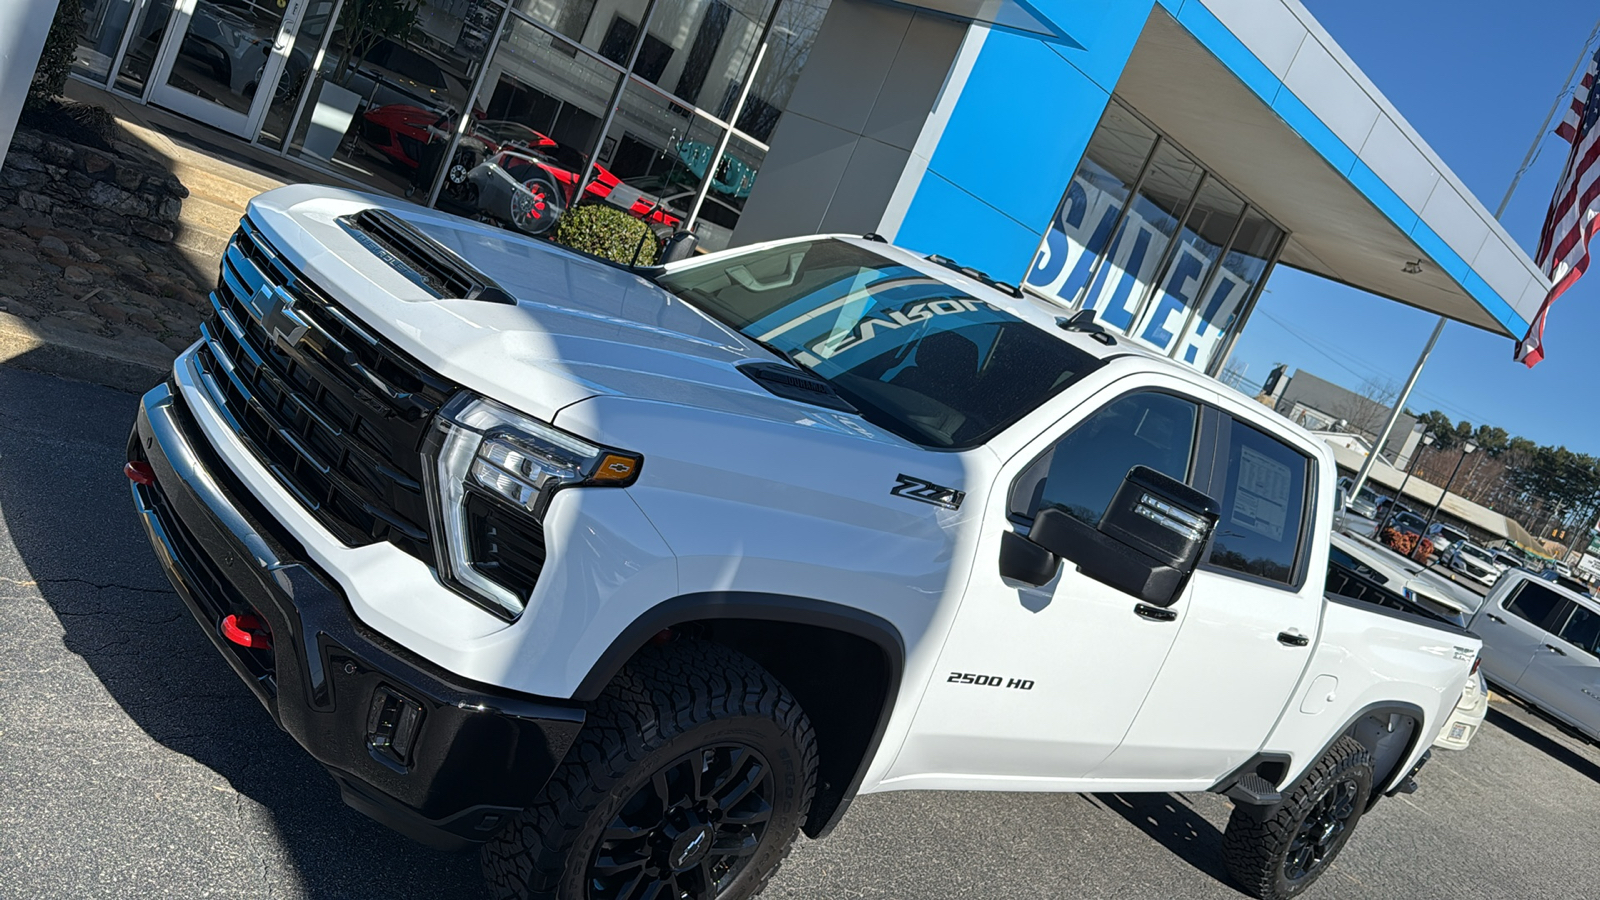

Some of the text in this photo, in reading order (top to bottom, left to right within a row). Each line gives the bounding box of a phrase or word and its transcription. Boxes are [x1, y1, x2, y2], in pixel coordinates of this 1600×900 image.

[1027, 180, 1237, 365] SALE!
[890, 473, 966, 511] Z71
[947, 672, 1035, 690] 2500 HD
